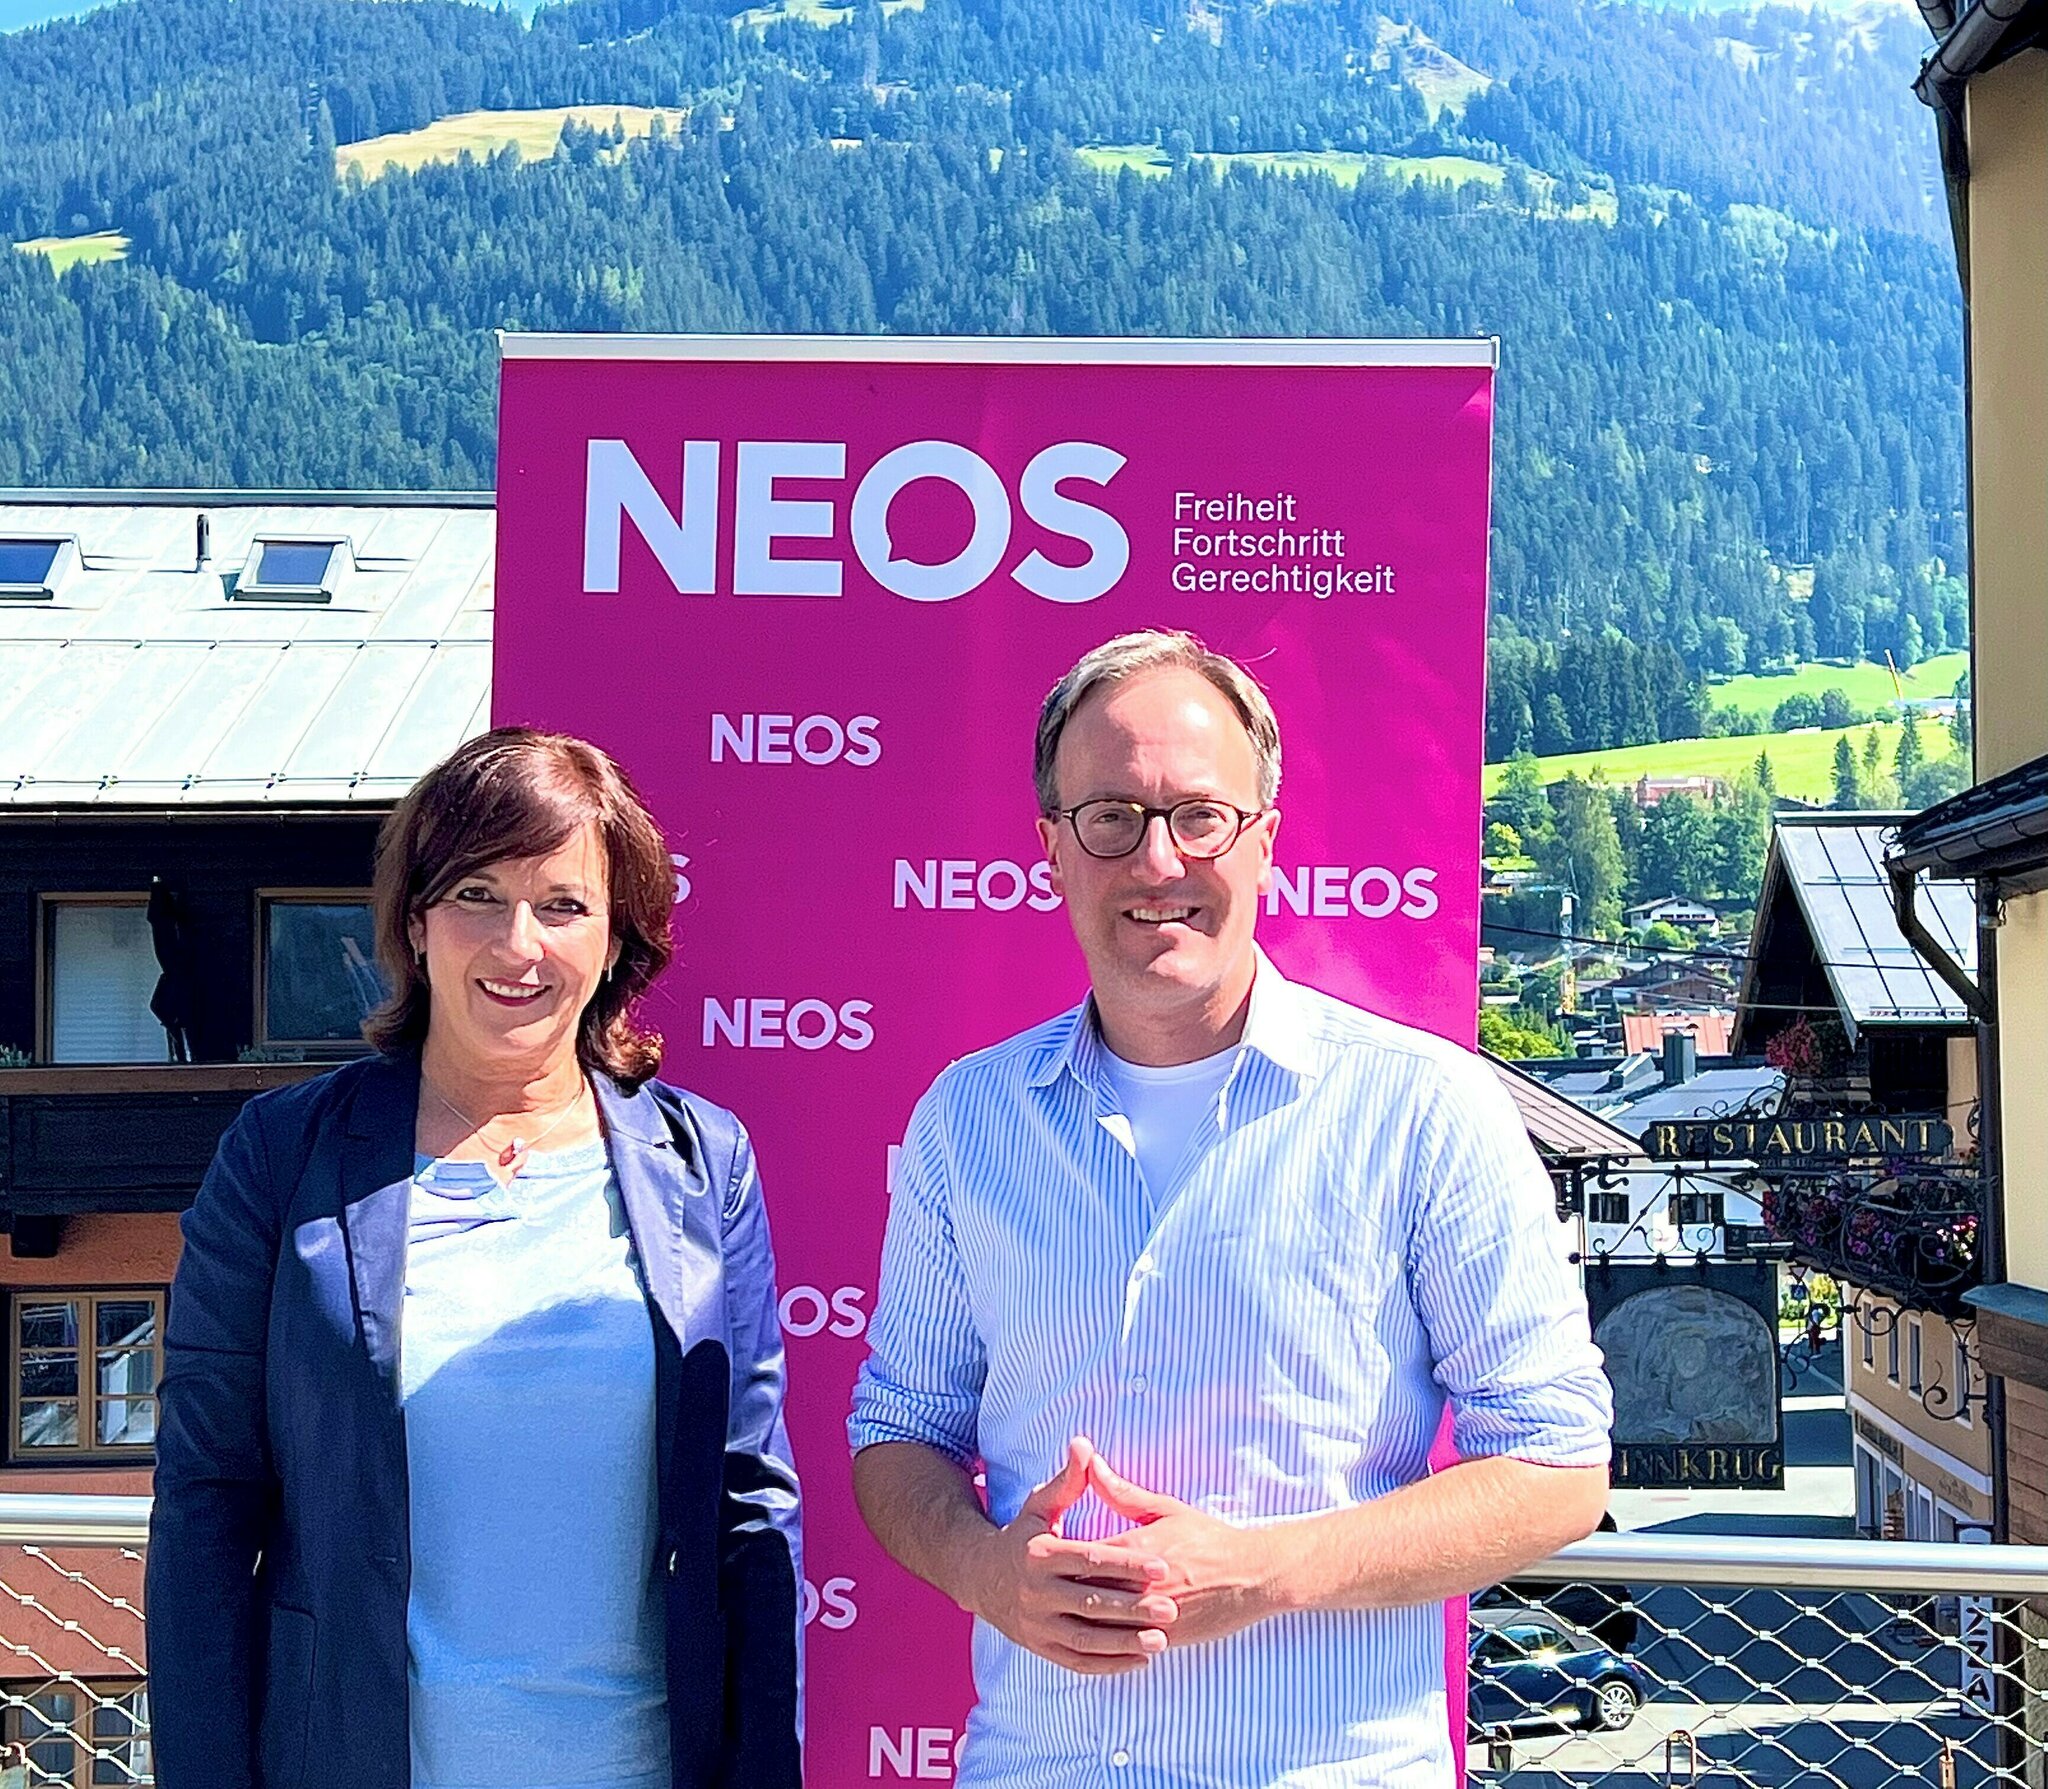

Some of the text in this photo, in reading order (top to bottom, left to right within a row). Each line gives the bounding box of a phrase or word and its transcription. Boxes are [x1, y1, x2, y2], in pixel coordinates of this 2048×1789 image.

[583, 439, 1130, 604] NEOS
[1174, 492, 1297, 522] Freiheit
[1173, 527, 1345, 557] Fortschritt
[1171, 562, 1395, 599] Gerechtigkeit
[710, 713, 881, 767] NEOS
[894, 859, 1063, 912] NEOS
[1266, 866, 1439, 920] NEOS
[702, 997, 874, 1051] NEOS
[1655, 1118, 1938, 1156] RESTAURANT
[777, 1286, 866, 1338] OS
[1619, 1448, 1779, 1482] INNKRUG
[868, 1726, 967, 1779] NE
